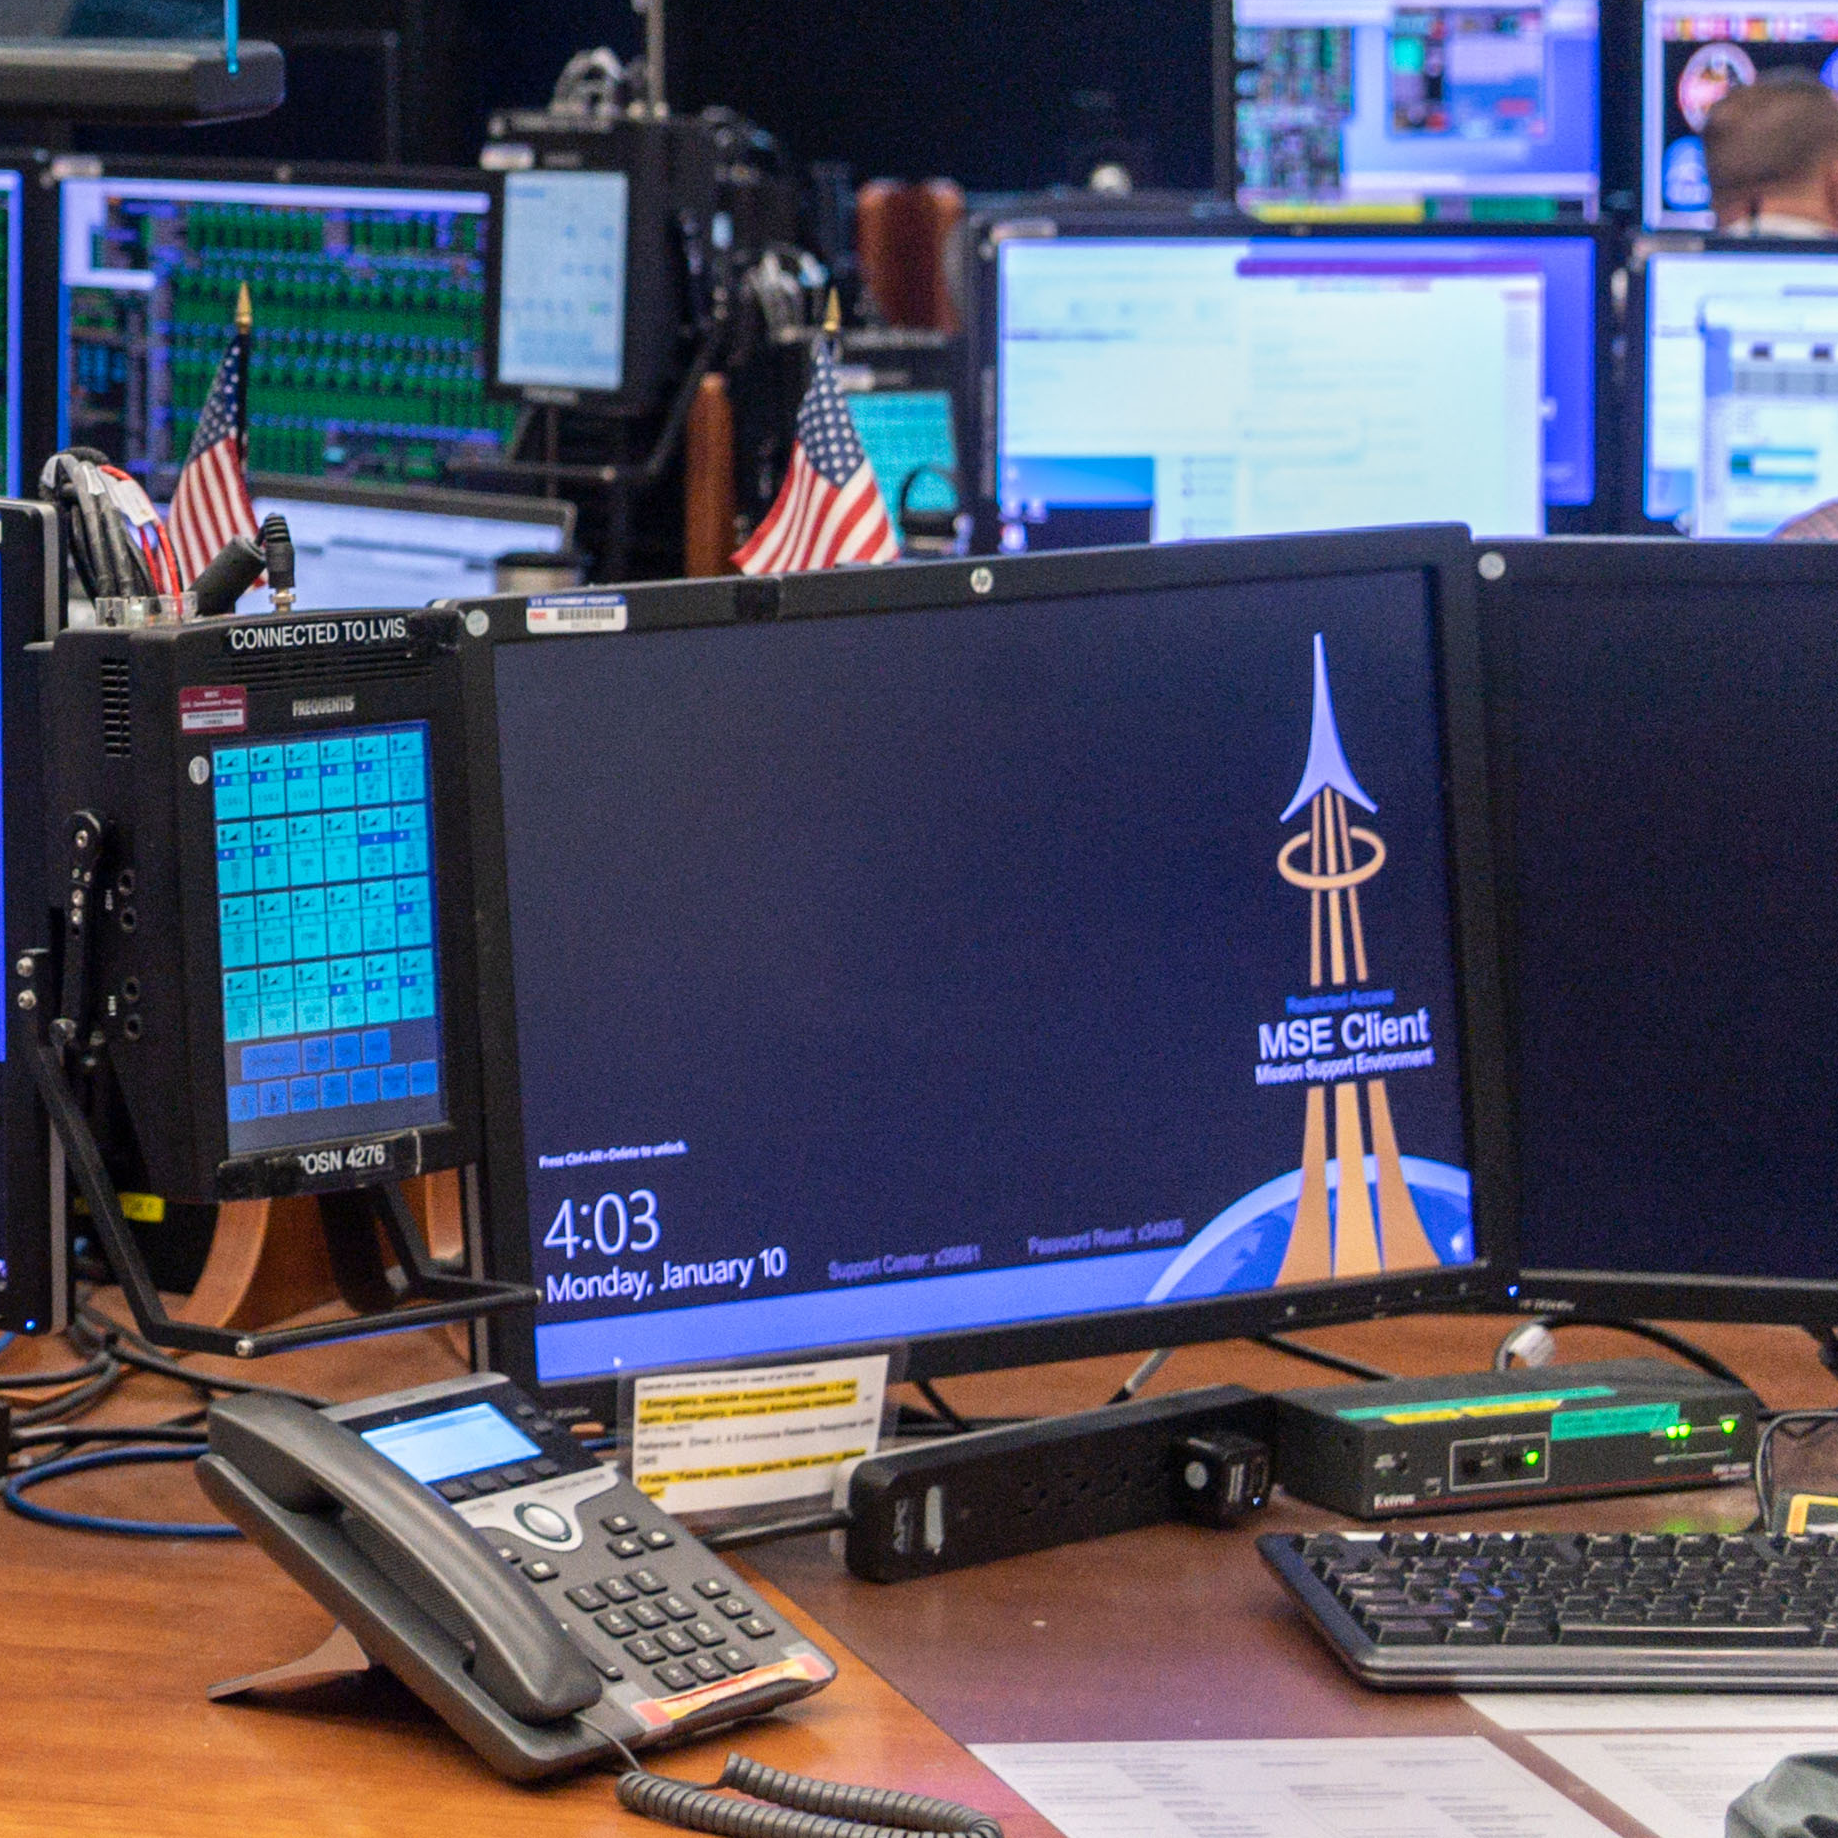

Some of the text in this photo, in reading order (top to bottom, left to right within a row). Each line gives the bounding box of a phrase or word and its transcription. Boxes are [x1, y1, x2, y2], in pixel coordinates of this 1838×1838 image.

[230, 617, 407, 650] CONNECTED TO LVIS
[292, 696, 355, 717] FREQUENTIS
[1259, 1007, 1431, 1060] MSE Client
[1255, 1046, 1435, 1085] Mission Support Environment
[346, 1143, 386, 1168] 4276
[539, 1154, 564, 1169] Press
[543, 1188, 662, 1260] 4:03
[1028, 1229, 1088, 1257] Password
[545, 1246, 788, 1305] Monday, January 10
[828, 1255, 881, 1283] Support
[1374, 1493, 1416, 1510] Extron
